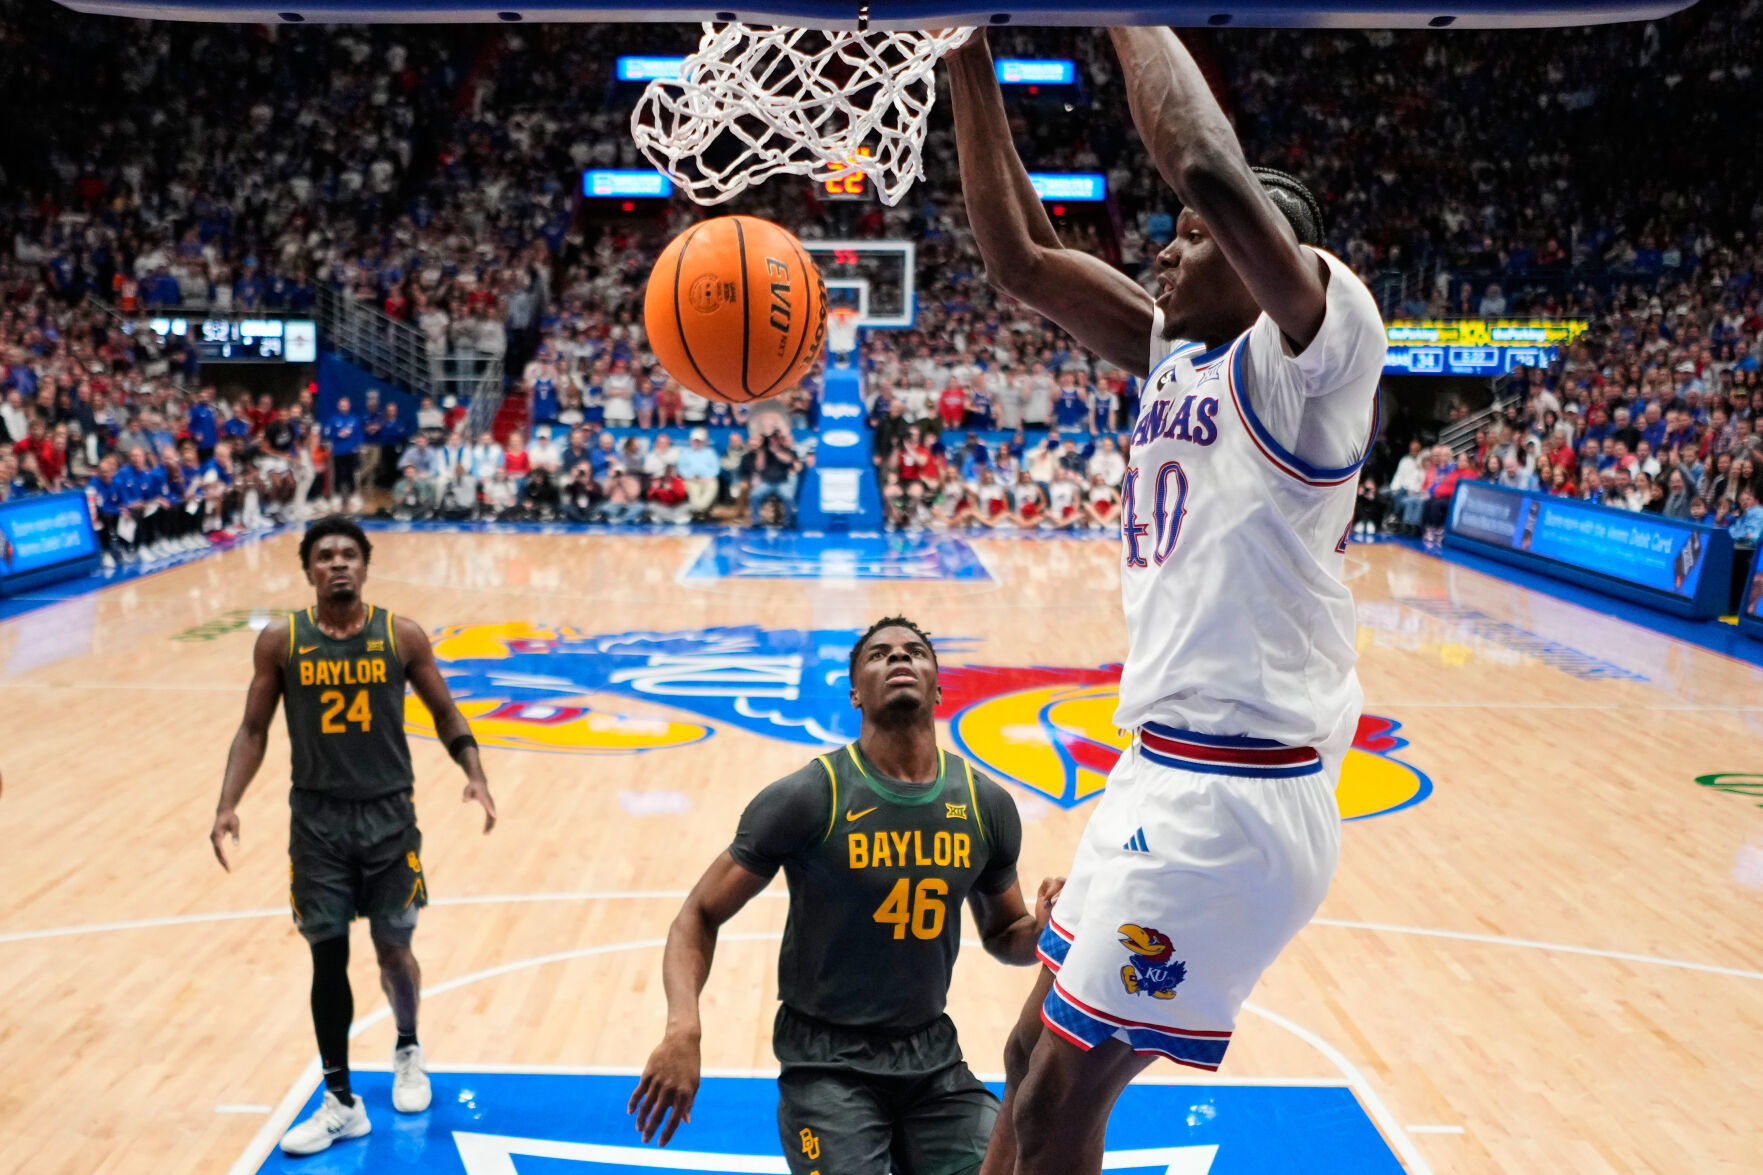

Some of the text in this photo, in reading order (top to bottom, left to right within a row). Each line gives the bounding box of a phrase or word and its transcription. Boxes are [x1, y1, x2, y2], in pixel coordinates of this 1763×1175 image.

[765, 257, 792, 333] EVO
[1130, 395, 1219, 447] ANAS
[1121, 460, 1188, 568] 40
[300, 658, 387, 686] BAYLOR
[320, 689, 372, 734] 24
[848, 830, 971, 869] BAYLOR
[872, 877, 949, 940] 46
[1145, 966, 1168, 983] KU
[800, 1127, 820, 1160] BU
